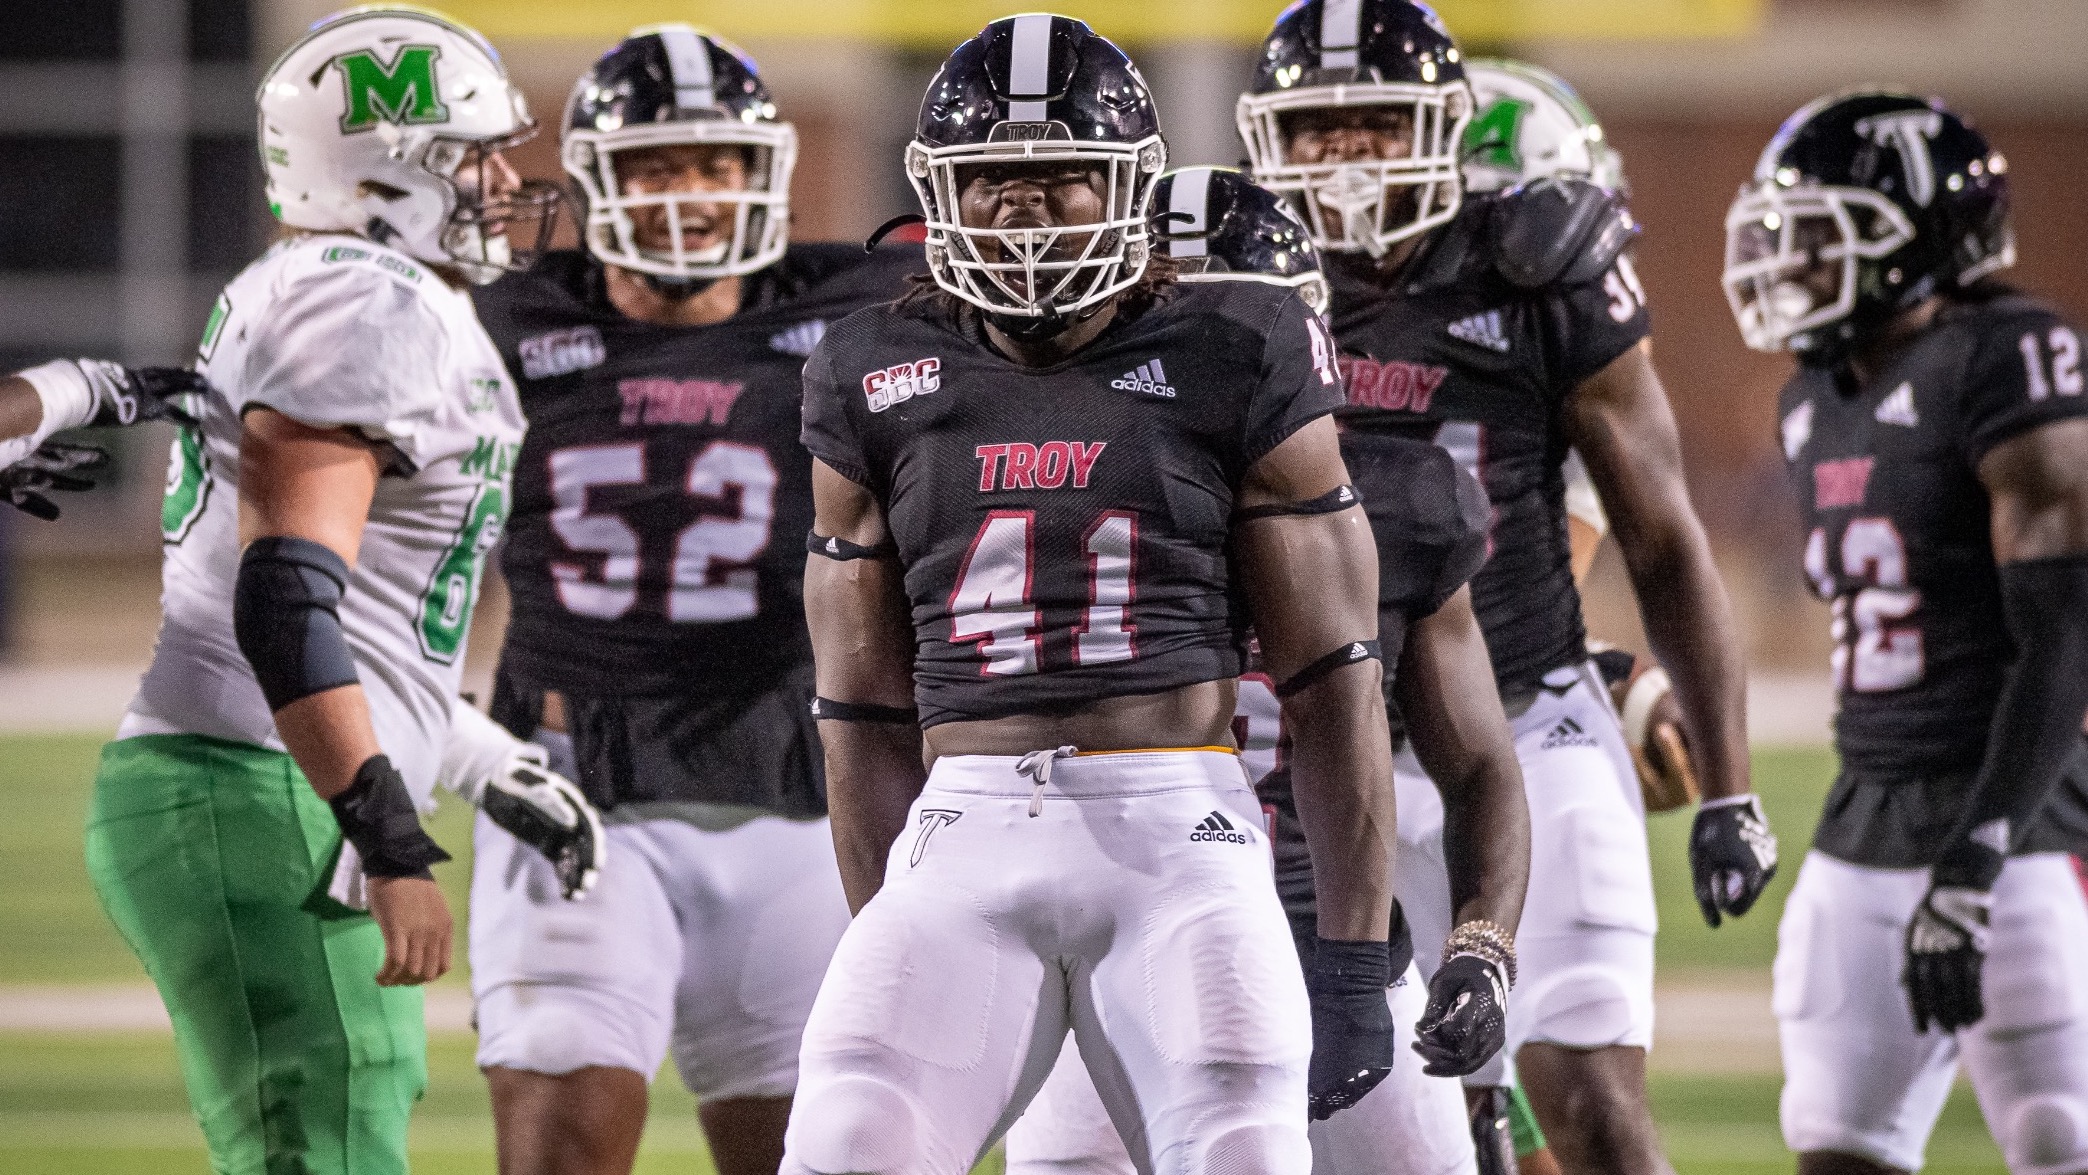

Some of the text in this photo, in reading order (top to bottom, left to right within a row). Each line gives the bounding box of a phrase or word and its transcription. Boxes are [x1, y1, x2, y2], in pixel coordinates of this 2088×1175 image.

[333, 44, 450, 136] M
[1006, 124, 1052, 142] TROY
[862, 357, 941, 413] SBC
[1111, 377, 1176, 398] adidas
[2019, 327, 2084, 400] 12
[975, 440, 1107, 492] TROY
[549, 440, 780, 622] 52
[946, 509, 1139, 677] 41
[1190, 829, 1246, 845] adidas
